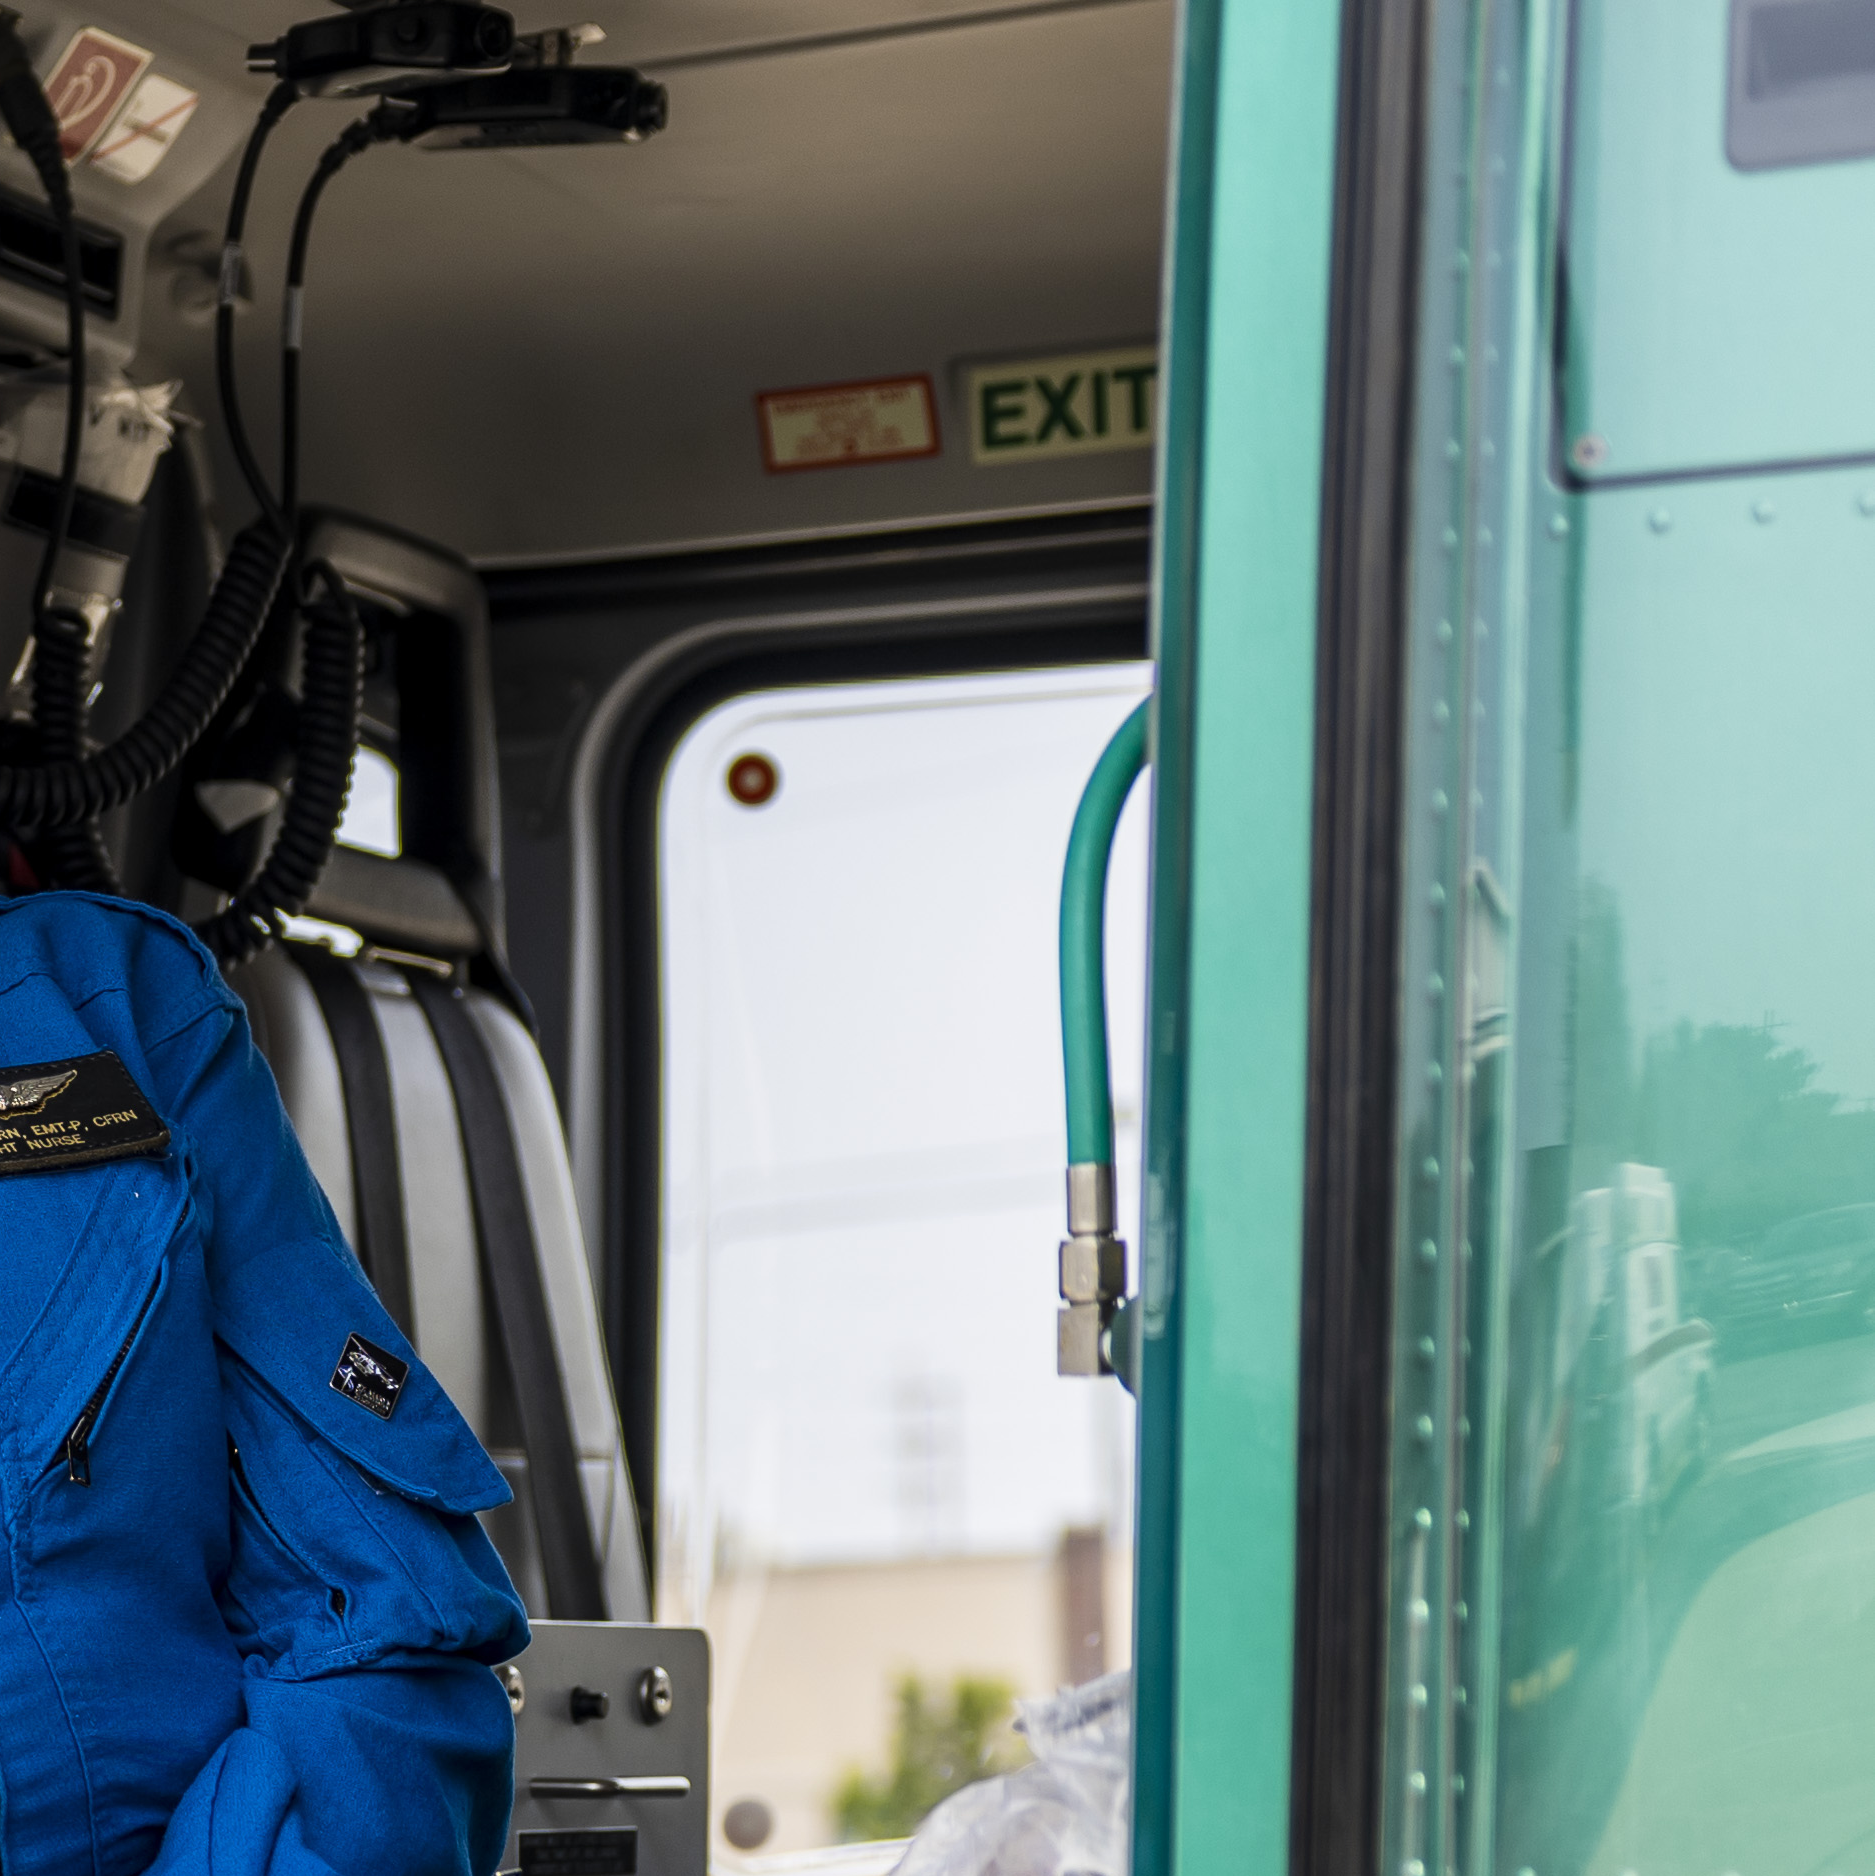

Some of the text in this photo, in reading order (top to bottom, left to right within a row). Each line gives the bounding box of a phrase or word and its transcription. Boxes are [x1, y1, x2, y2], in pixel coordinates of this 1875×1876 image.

[981, 366, 1157, 448] EXIT
[30, 1120, 89, 1137] EMT-P,
[92, 1109, 138, 1128] CFRN
[26, 1133, 86, 1151] NURSE
